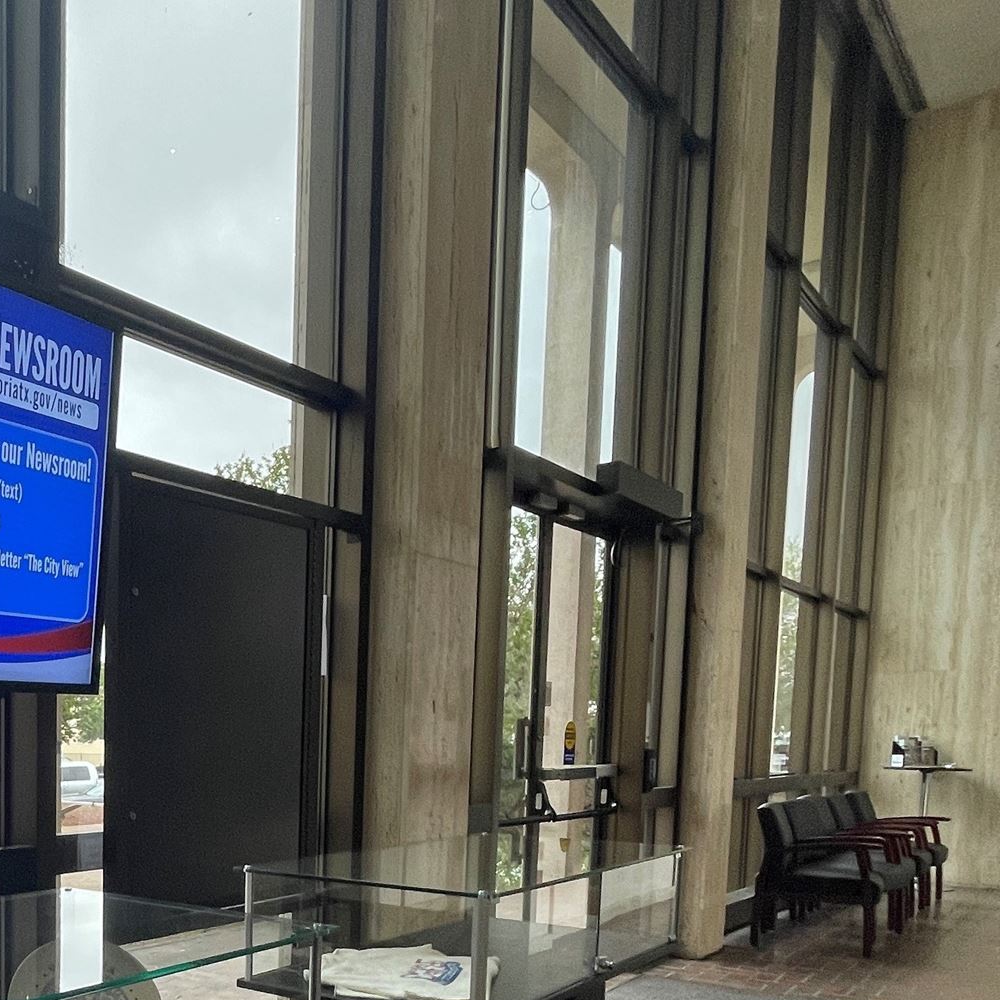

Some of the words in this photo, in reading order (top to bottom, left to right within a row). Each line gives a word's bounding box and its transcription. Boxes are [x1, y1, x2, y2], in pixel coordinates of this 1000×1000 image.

[1, 441, 24, 466] our
[26, 441, 92, 483] Newsroom!
[23, 553, 43, 573] "The
[44, 556, 60, 579] City
